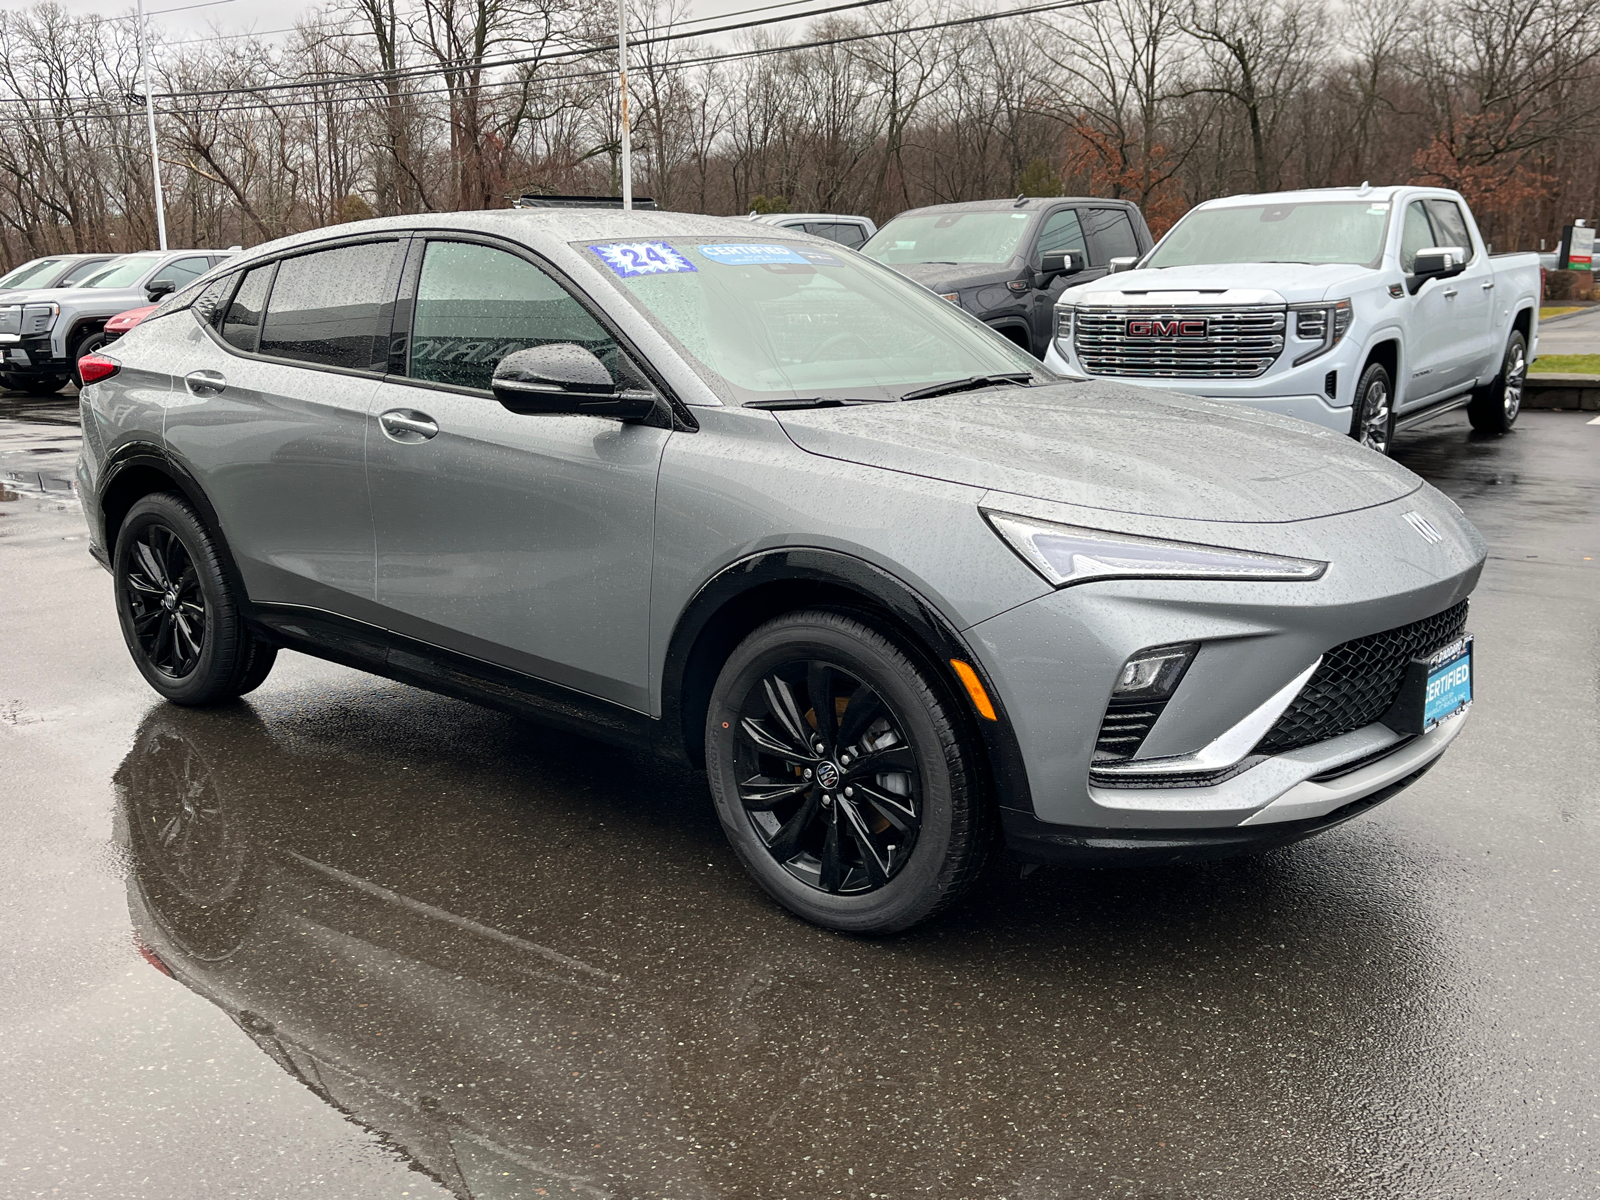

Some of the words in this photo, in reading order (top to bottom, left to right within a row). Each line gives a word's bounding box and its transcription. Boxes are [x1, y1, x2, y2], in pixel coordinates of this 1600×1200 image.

[619, 246, 669, 267] 24
[702, 246, 791, 256] CERTIFIED
[1129, 321, 1205, 337] GMC
